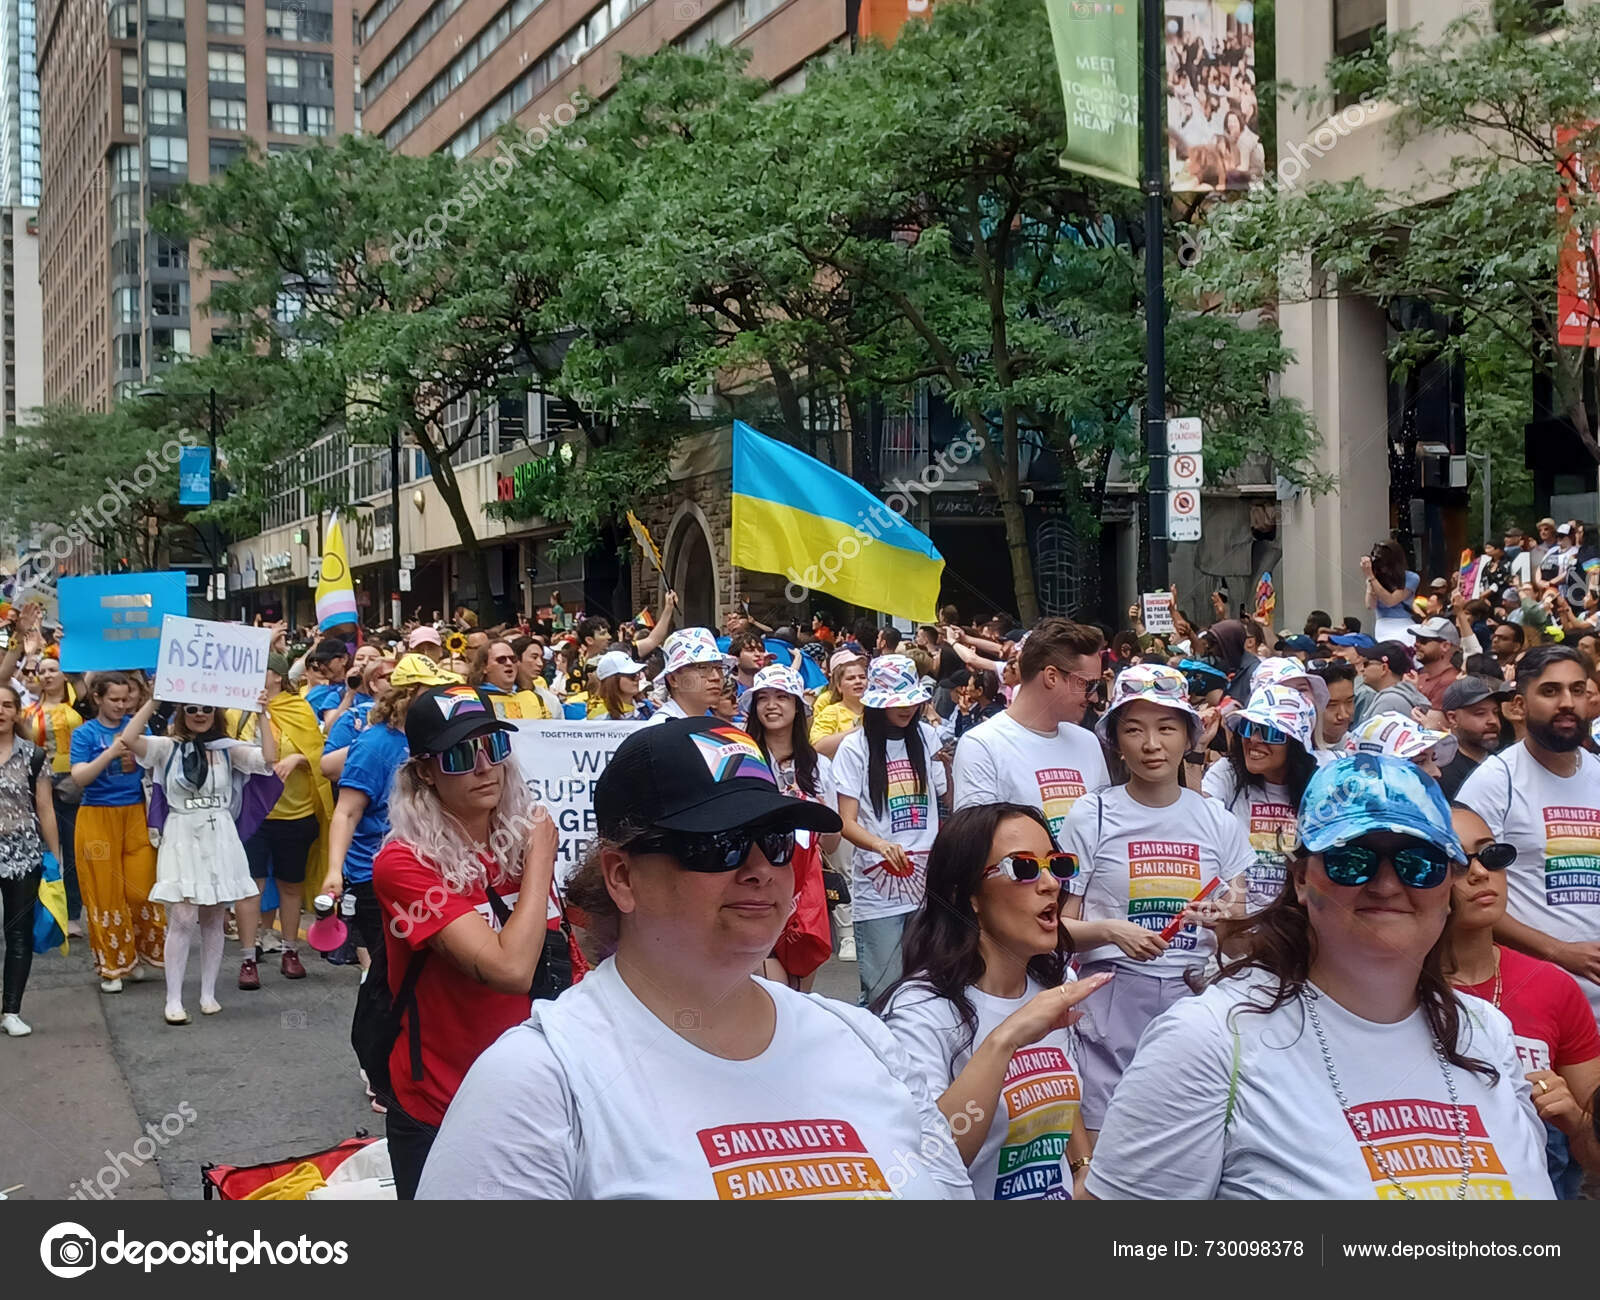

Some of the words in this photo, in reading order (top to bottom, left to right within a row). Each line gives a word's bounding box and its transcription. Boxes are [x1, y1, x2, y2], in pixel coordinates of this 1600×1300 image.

[1076, 55, 1115, 72] MEET
[1102, 73, 1117, 89] IN
[168, 639, 264, 674] ASEXUAL
[541, 731, 583, 739] TOGETHER
[584, 731, 605, 739] WITH
[1547, 809, 1597, 820] SMIRNOFF
[1133, 843, 1195, 857] SMIRNOFF
[1135, 862, 1196, 875] SMIRNOFF
[1004, 1051, 1063, 1081] MIRNOFF
[1011, 1078, 1075, 1111] SMIRNOFF
[711, 1124, 846, 1157] SMIRNOFF
[727, 1162, 870, 1200] SMIRNOFF
